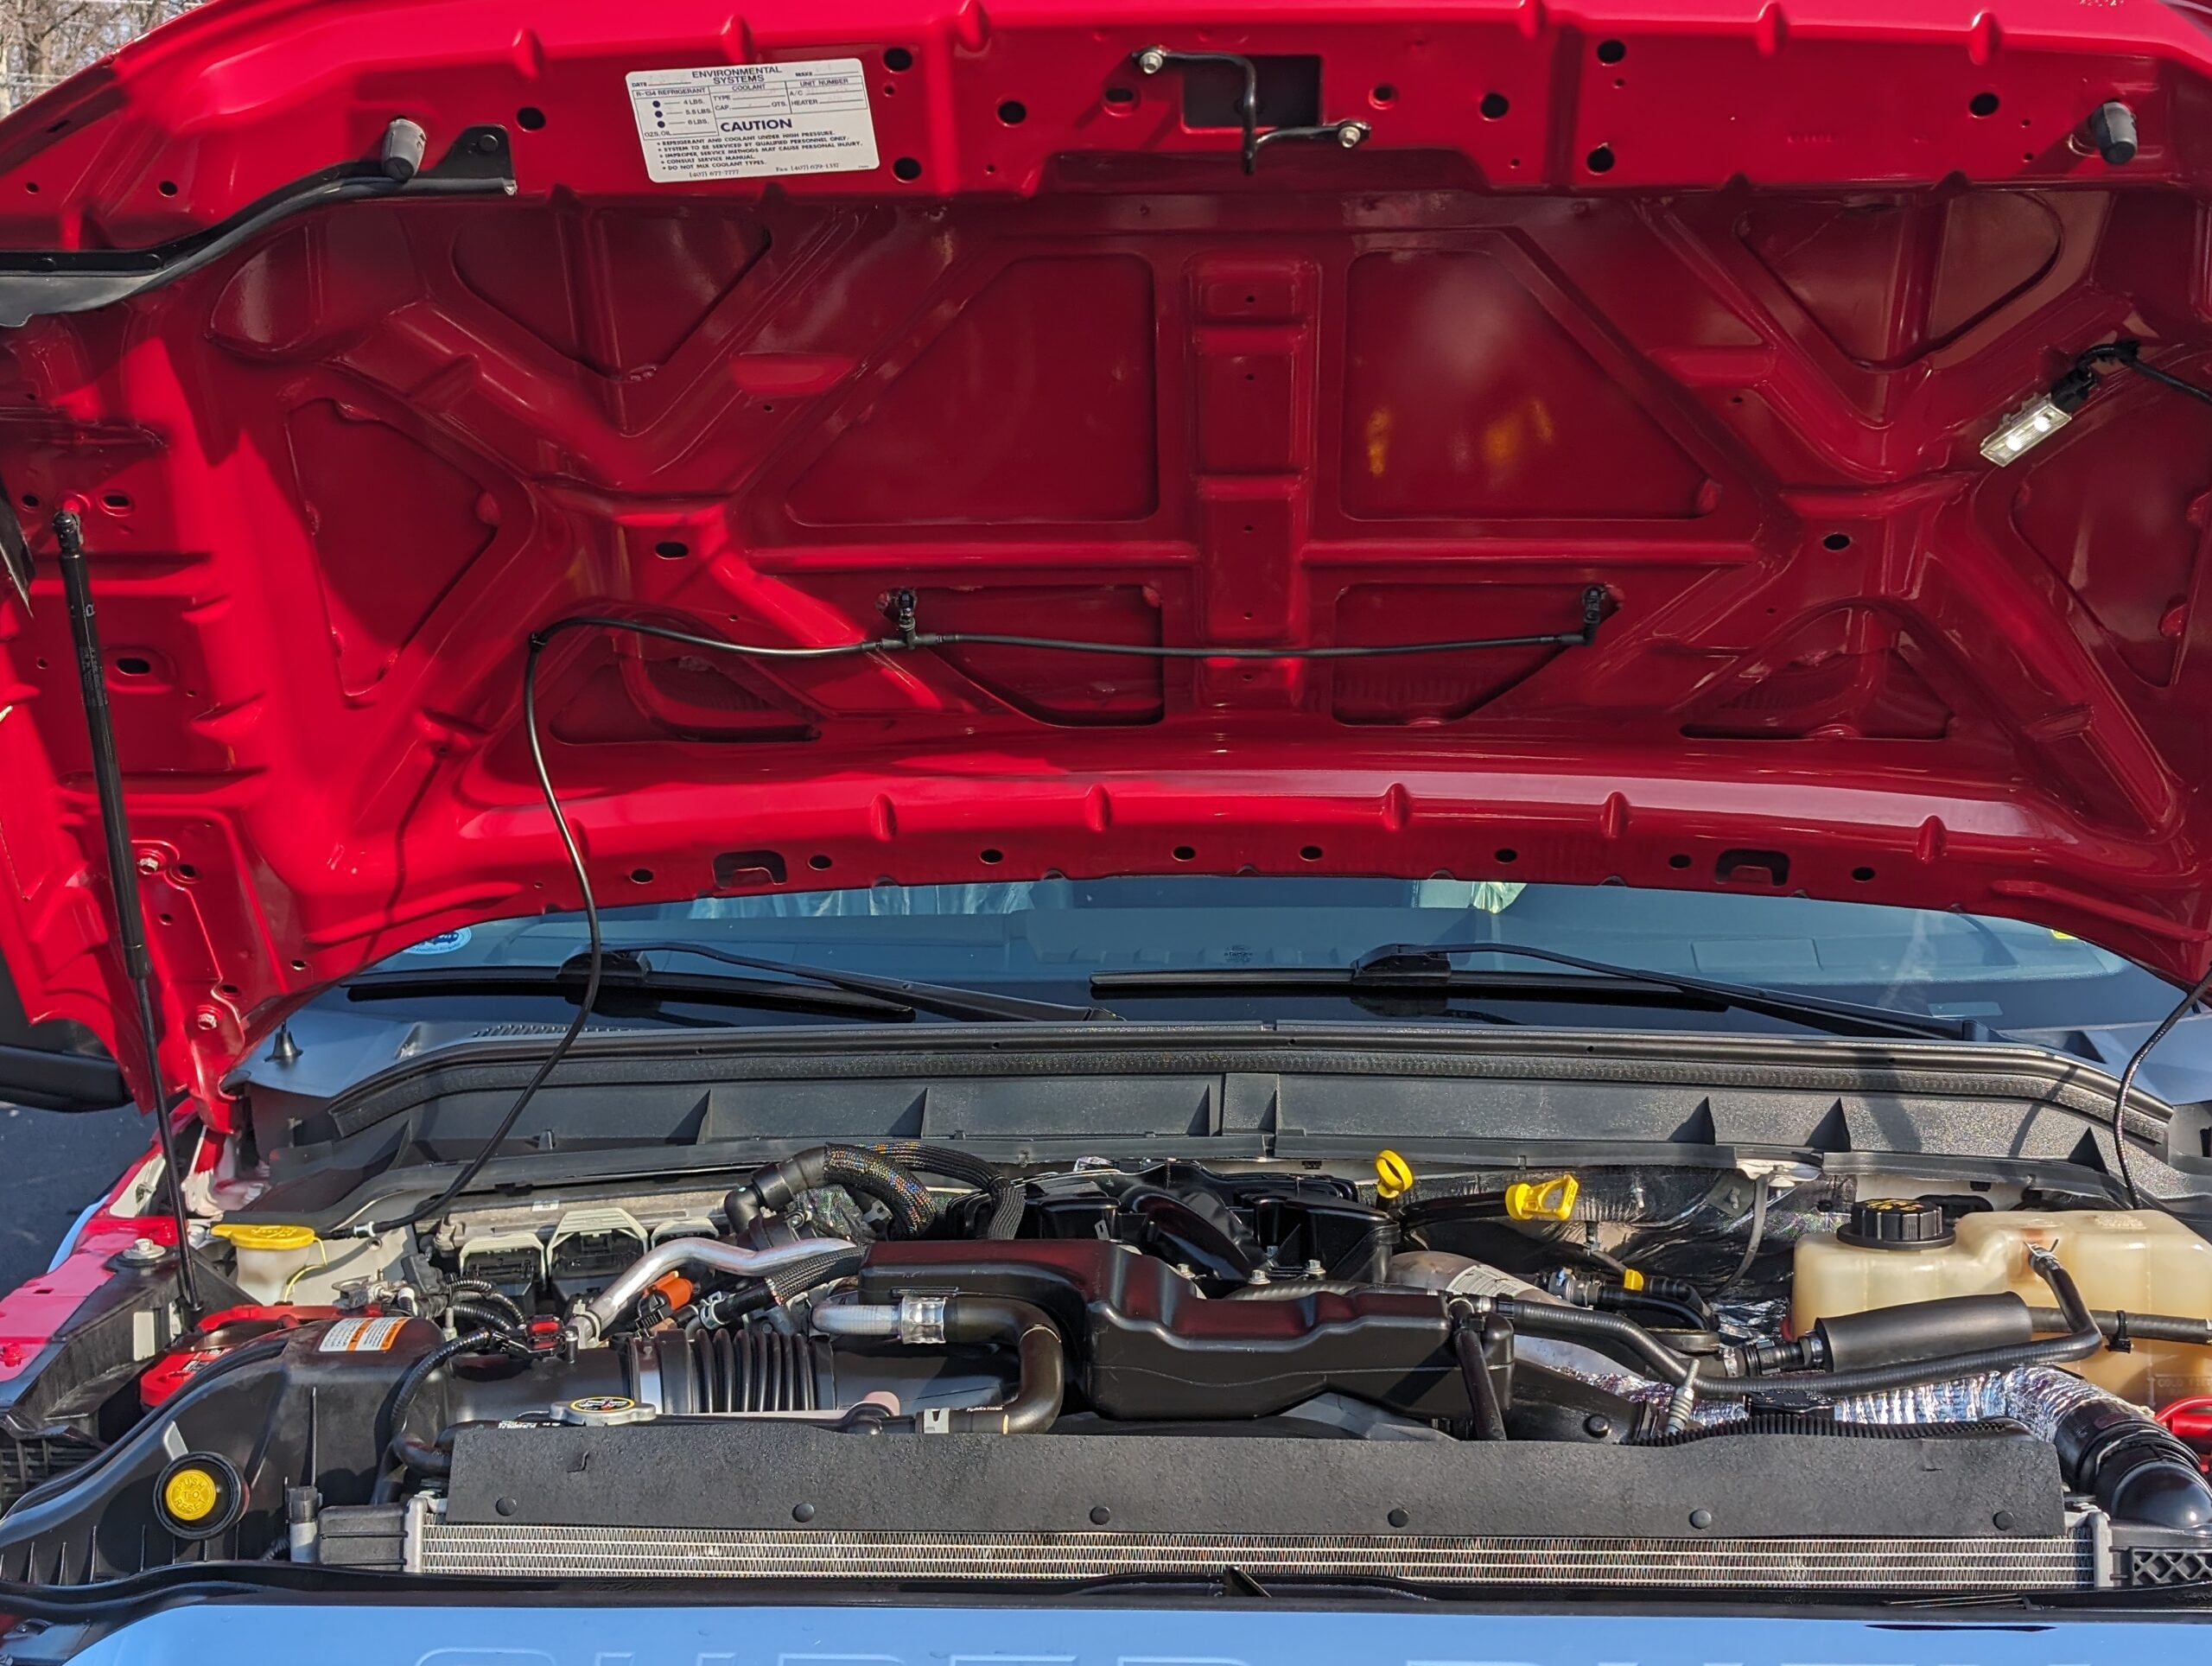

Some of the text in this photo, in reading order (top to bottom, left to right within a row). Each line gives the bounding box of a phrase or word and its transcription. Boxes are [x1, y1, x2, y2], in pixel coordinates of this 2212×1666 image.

[692, 67, 782, 79] ENVIRONMENTAL
[713, 74, 764, 85] SYSTEMS
[658, 87, 706, 96] REFRIGERANT
[721, 118, 792, 131] CAUTION
[176, 1477, 205, 1491] PUSH
[183, 1491, 200, 1499] TO
[174, 1497, 207, 1512] RESET
